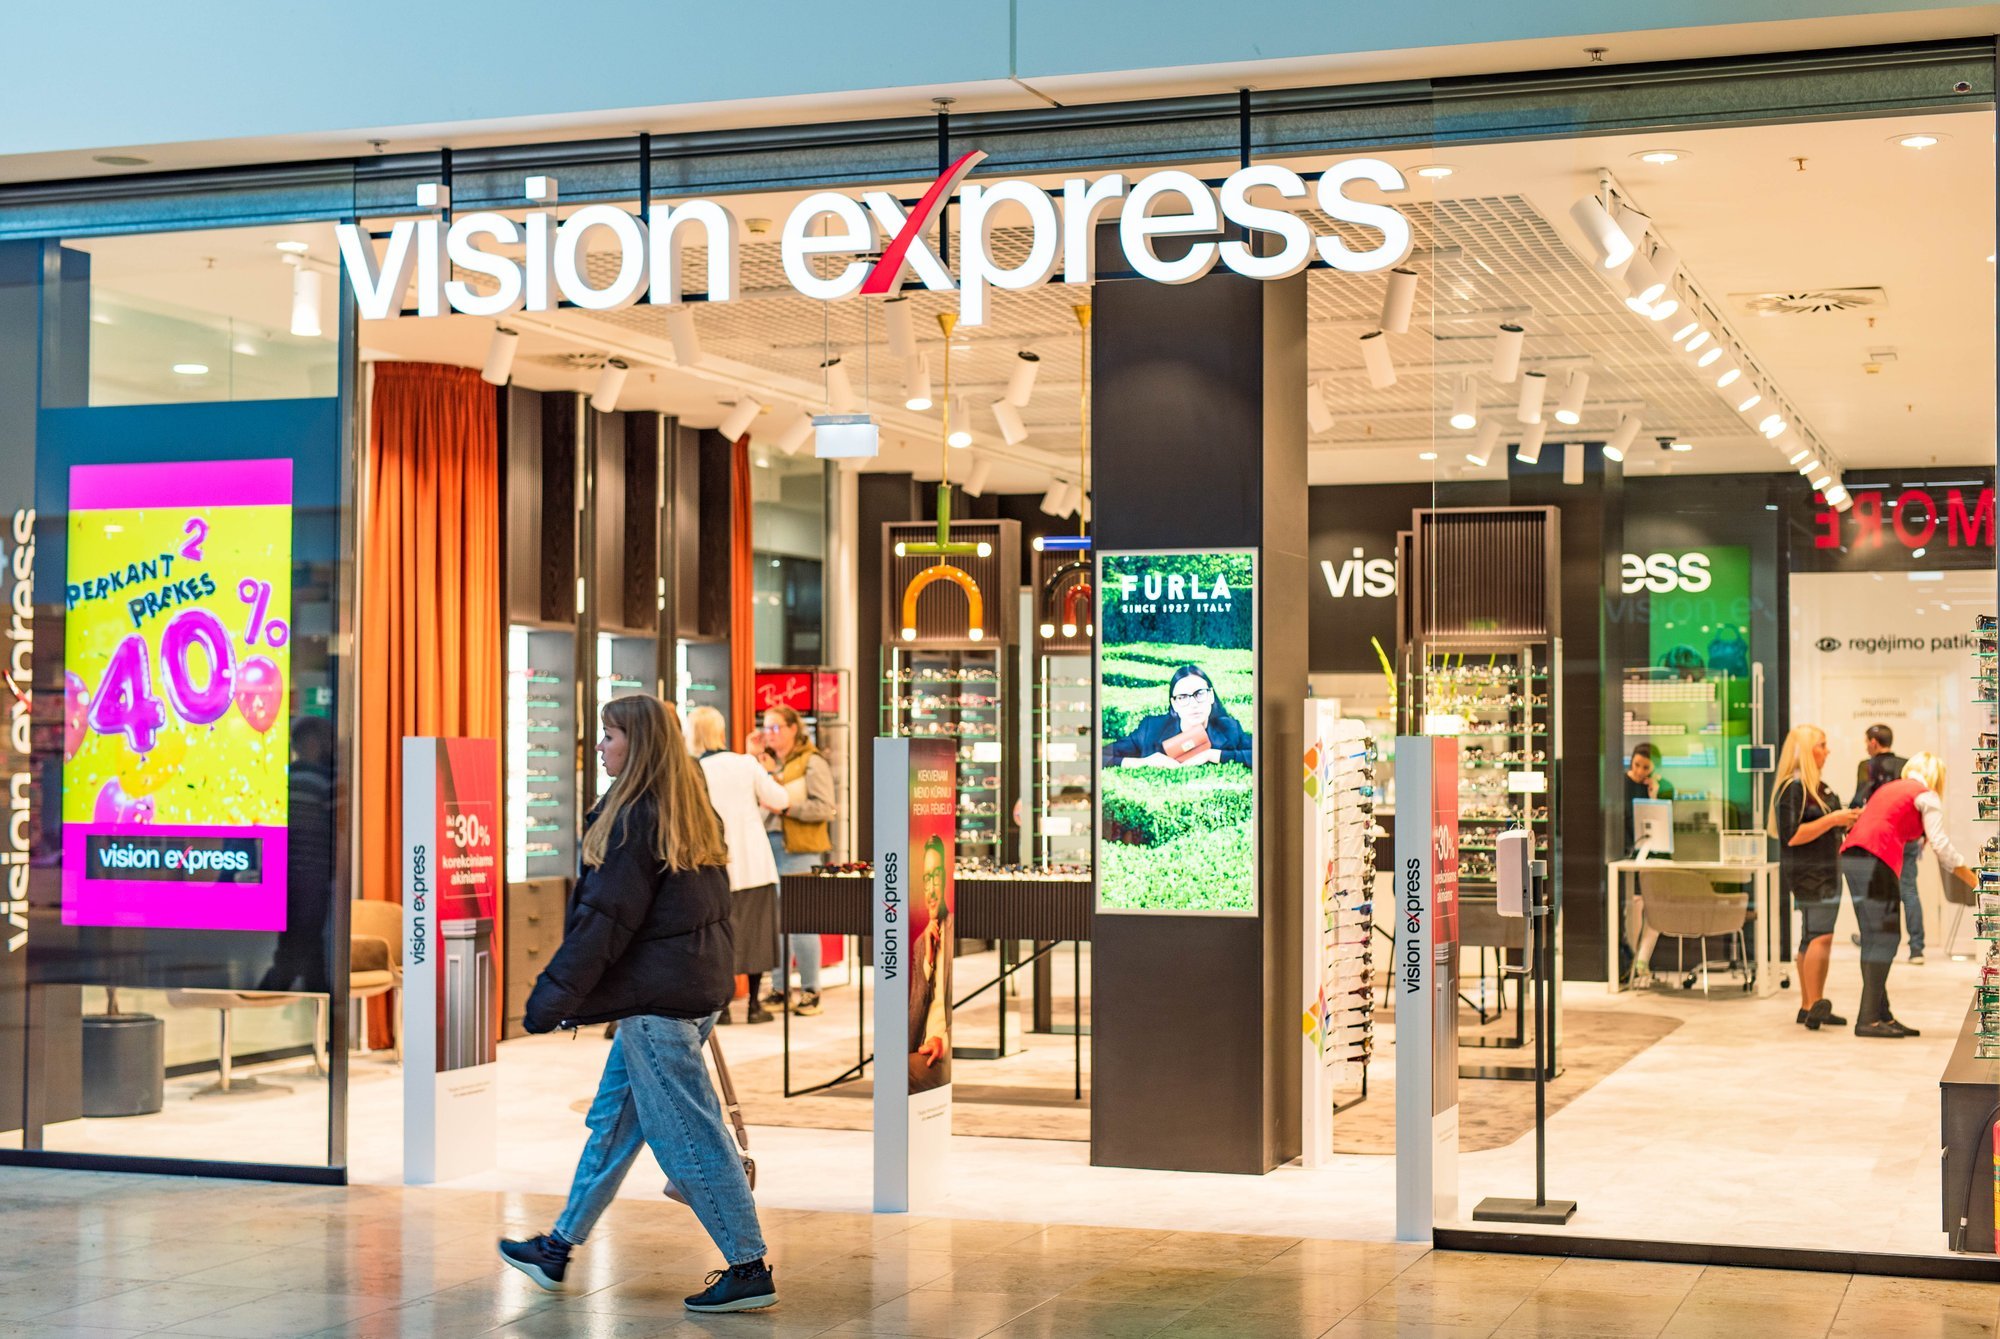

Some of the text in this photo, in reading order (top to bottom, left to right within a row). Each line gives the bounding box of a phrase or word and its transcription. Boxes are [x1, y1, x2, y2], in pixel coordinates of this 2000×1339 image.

[336, 149, 1416, 327] vision express
[66, 554, 174, 611] PERKANT
[179, 517, 208, 561] 2
[1121, 573, 1232, 601] FURLA
[1122, 603, 1232, 613] SINCE 1927 ITALY
[1, 772, 31, 953] vision
[99, 842, 249, 875] vision express
[410, 844, 429, 965] vision express
[881, 851, 901, 981] vision express
[1403, 857, 1424, 994] vision express
